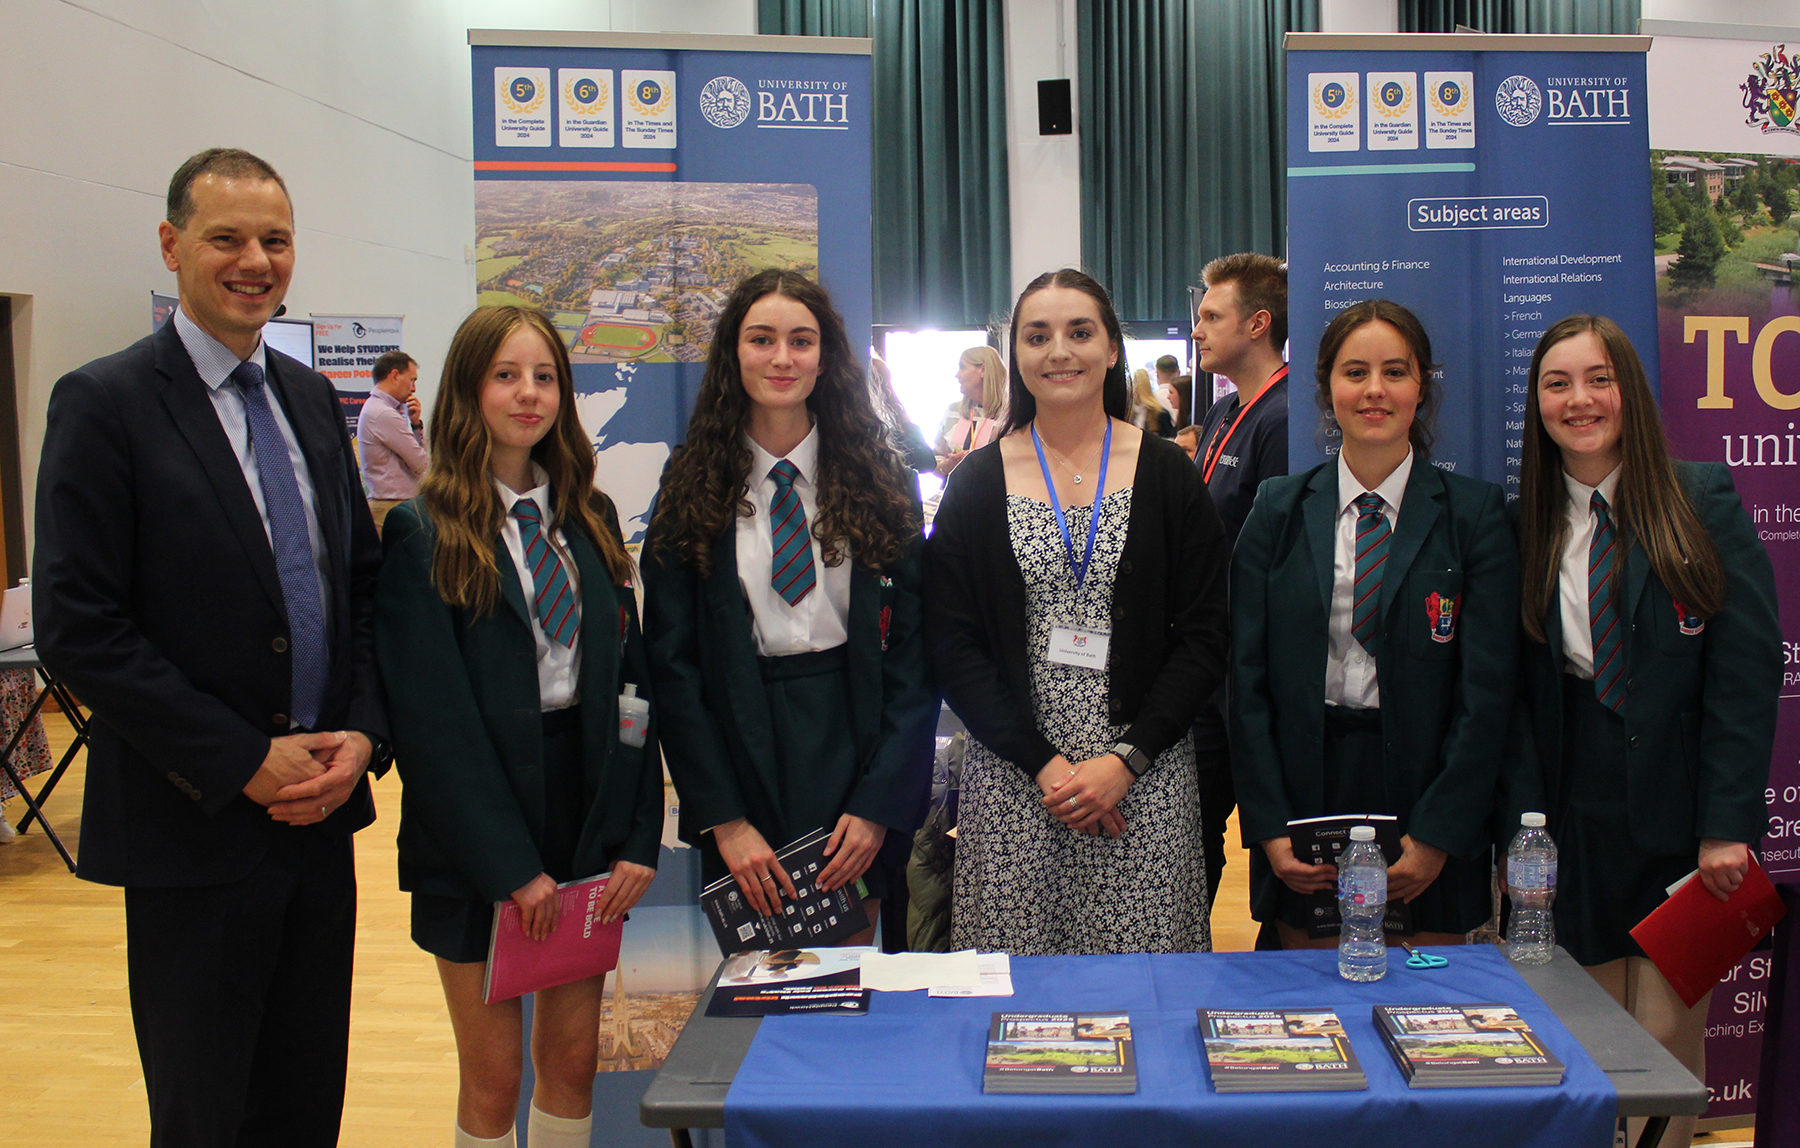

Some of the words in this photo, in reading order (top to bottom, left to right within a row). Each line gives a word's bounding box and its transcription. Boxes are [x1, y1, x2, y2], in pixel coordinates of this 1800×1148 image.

[758, 79, 829, 90] UNIVERSITY
[832, 81, 848, 91] OF
[1547, 77, 1611, 86] UNIVERSITY
[1613, 77, 1628, 86] OF
[516, 84, 533, 97] 5th
[579, 84, 596, 98] 6th
[642, 86, 659, 100] 8th
[1327, 89, 1343, 103] 5th
[1386, 88, 1402, 102] 6th
[1443, 87, 1459, 101] 8th
[757, 91, 849, 123] BATH
[1546, 89, 1631, 118] BATH
[1417, 204, 1488, 226] Subject
[1492, 206, 1541, 221] areas
[1323, 261, 1380, 274] Accounting
[1382, 260, 1390, 270] &
[1391, 259, 1430, 270] Finance
[1502, 255, 1559, 267] International
[1560, 253, 1622, 267] Development
[1323, 279, 1384, 291] Architecture
[1503, 274, 1559, 285] International
[1560, 272, 1602, 283] Relations
[1503, 293, 1552, 304] Languages
[1511, 311, 1542, 321] French
[317, 345, 333, 353] We
[334, 345, 355, 354] Help
[357, 345, 400, 353] STUDENTS
[319, 357, 355, 366] Realise
[320, 370, 352, 379] Career
[1753, 504, 1769, 523] in
[1059, 648, 1081, 656] University
[1315, 829, 1346, 837] Connect
[589, 886, 598, 899] TO
[837, 889, 846, 904] with
[586, 900, 595, 913] BE
[583, 913, 593, 938] BOLD
